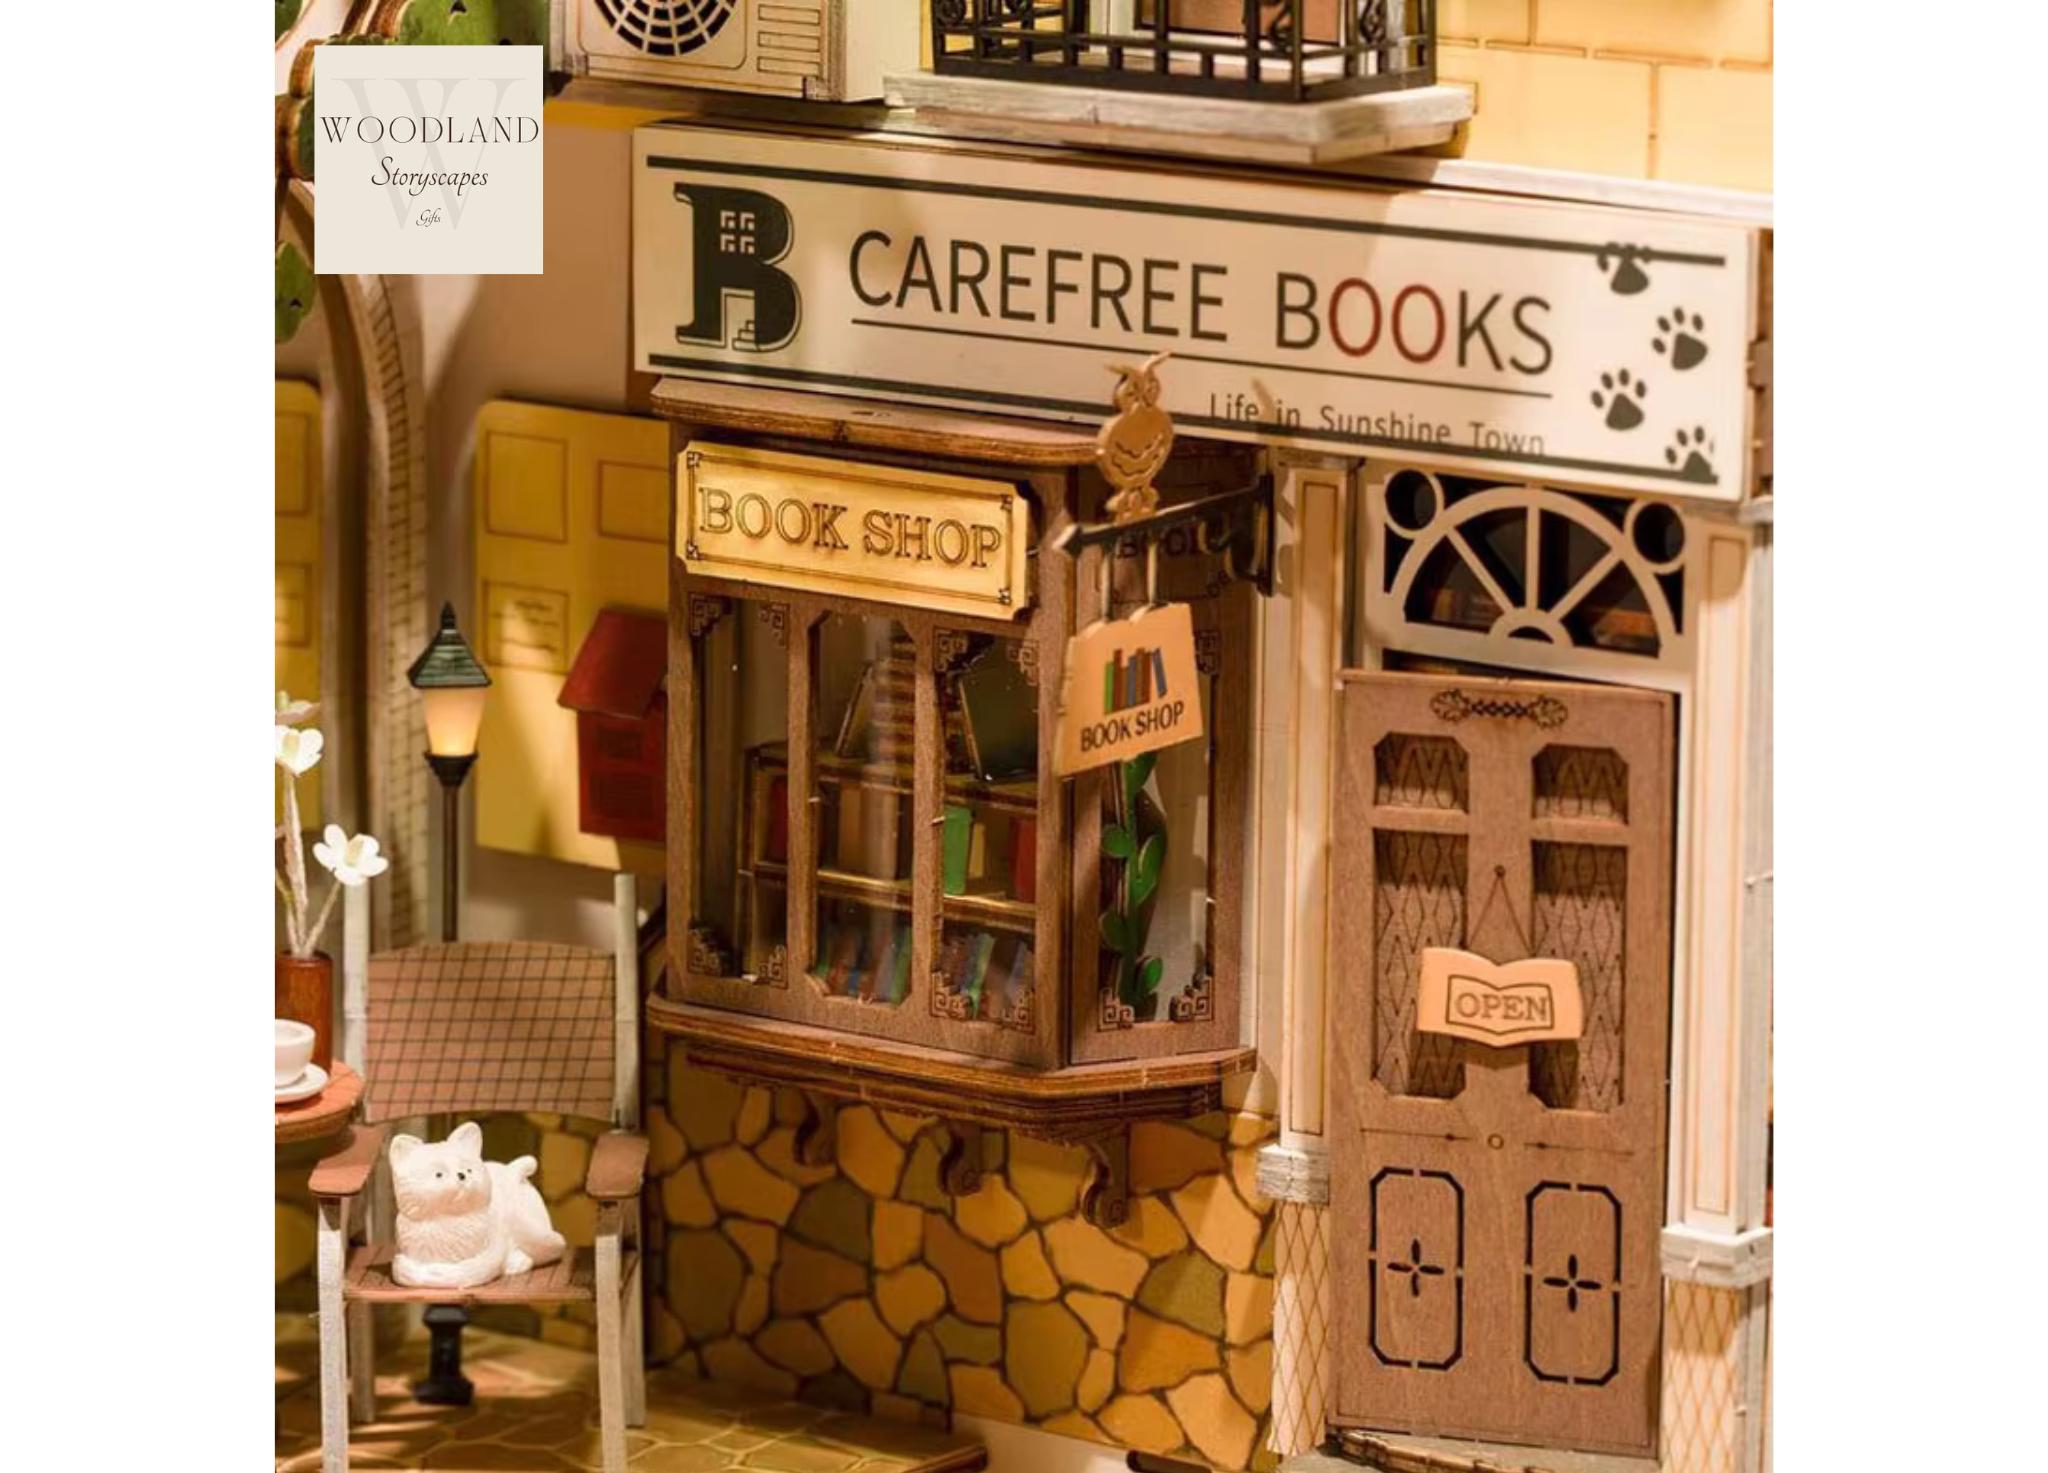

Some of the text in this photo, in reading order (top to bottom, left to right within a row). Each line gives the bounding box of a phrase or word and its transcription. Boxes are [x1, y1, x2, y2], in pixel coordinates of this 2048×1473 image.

[849, 229, 1554, 376] CAREFREE BOOKS
[1208, 392, 1546, 457] Life in Sunshine Town
[698, 486, 1002, 569] BOOK SHOP
[1081, 700, 1184, 752] BOOK SHOP
[1455, 991, 1549, 1023] OPEN
